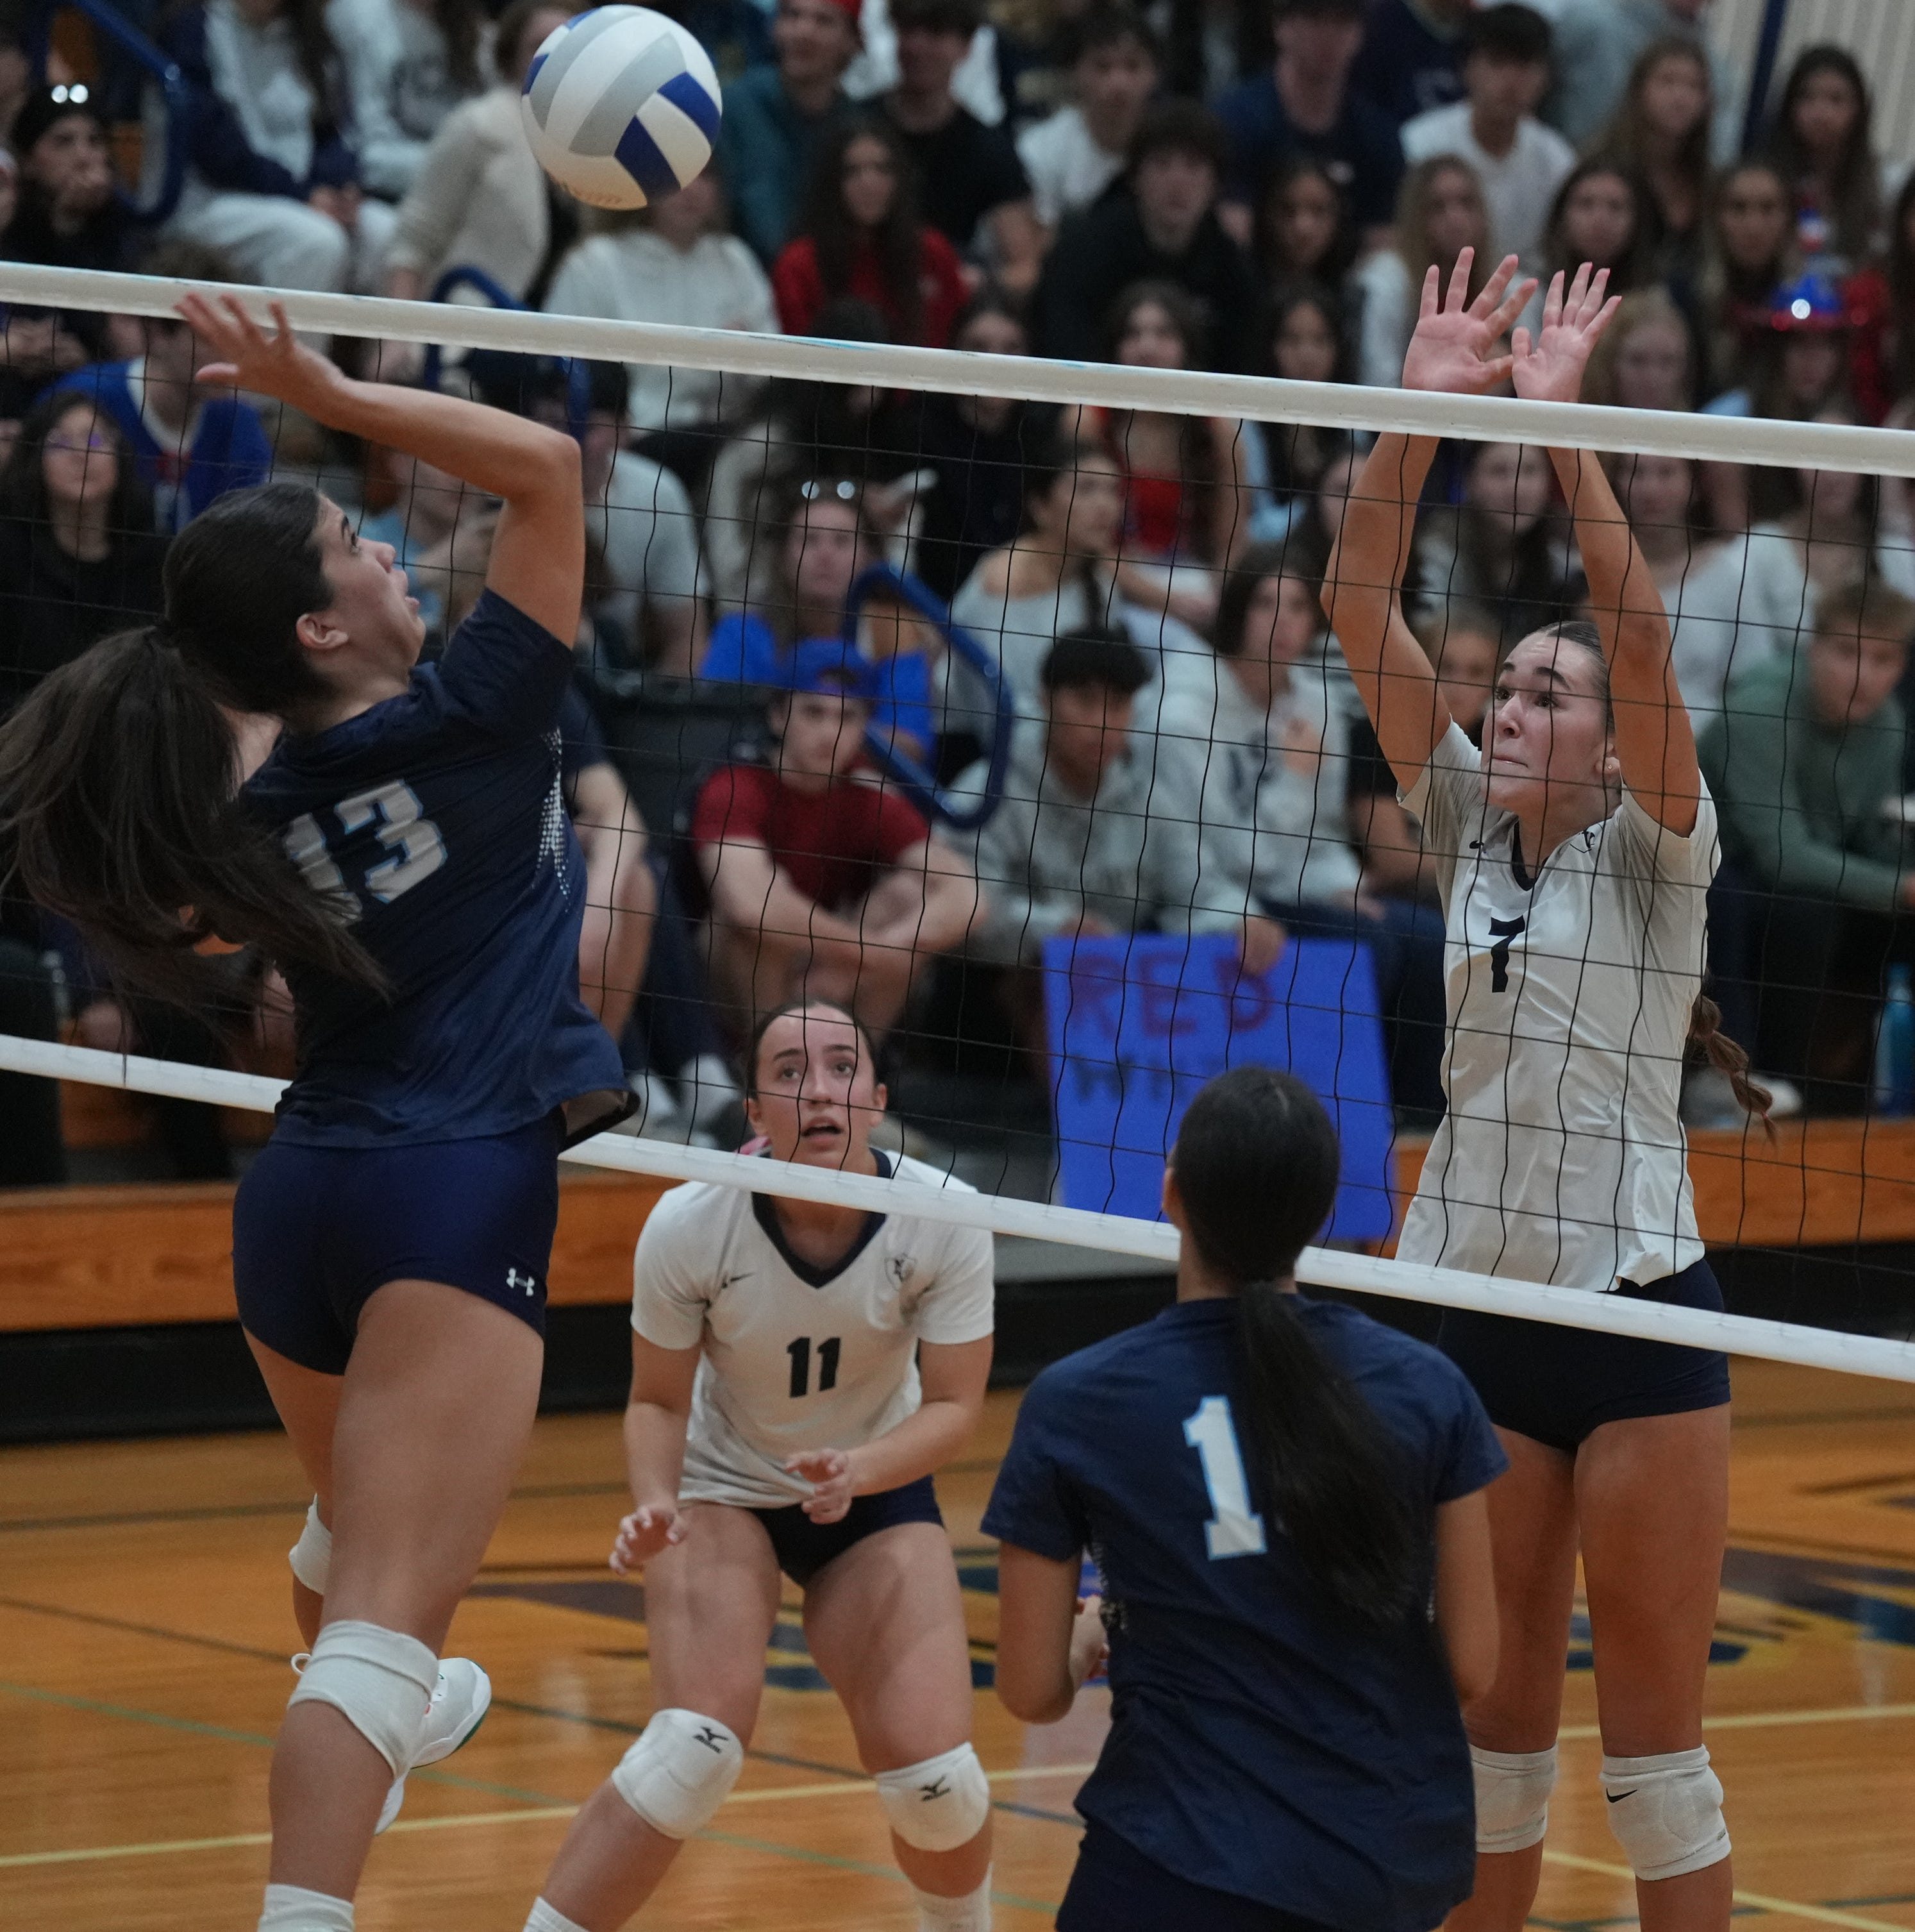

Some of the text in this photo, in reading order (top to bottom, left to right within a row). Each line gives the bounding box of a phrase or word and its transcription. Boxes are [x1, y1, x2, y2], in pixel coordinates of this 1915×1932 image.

[1488, 915, 1525, 993] 7
[1069, 952, 1273, 1039] RED
[787, 1337, 840, 1399] 11
[1182, 1395, 1268, 1560] 1
